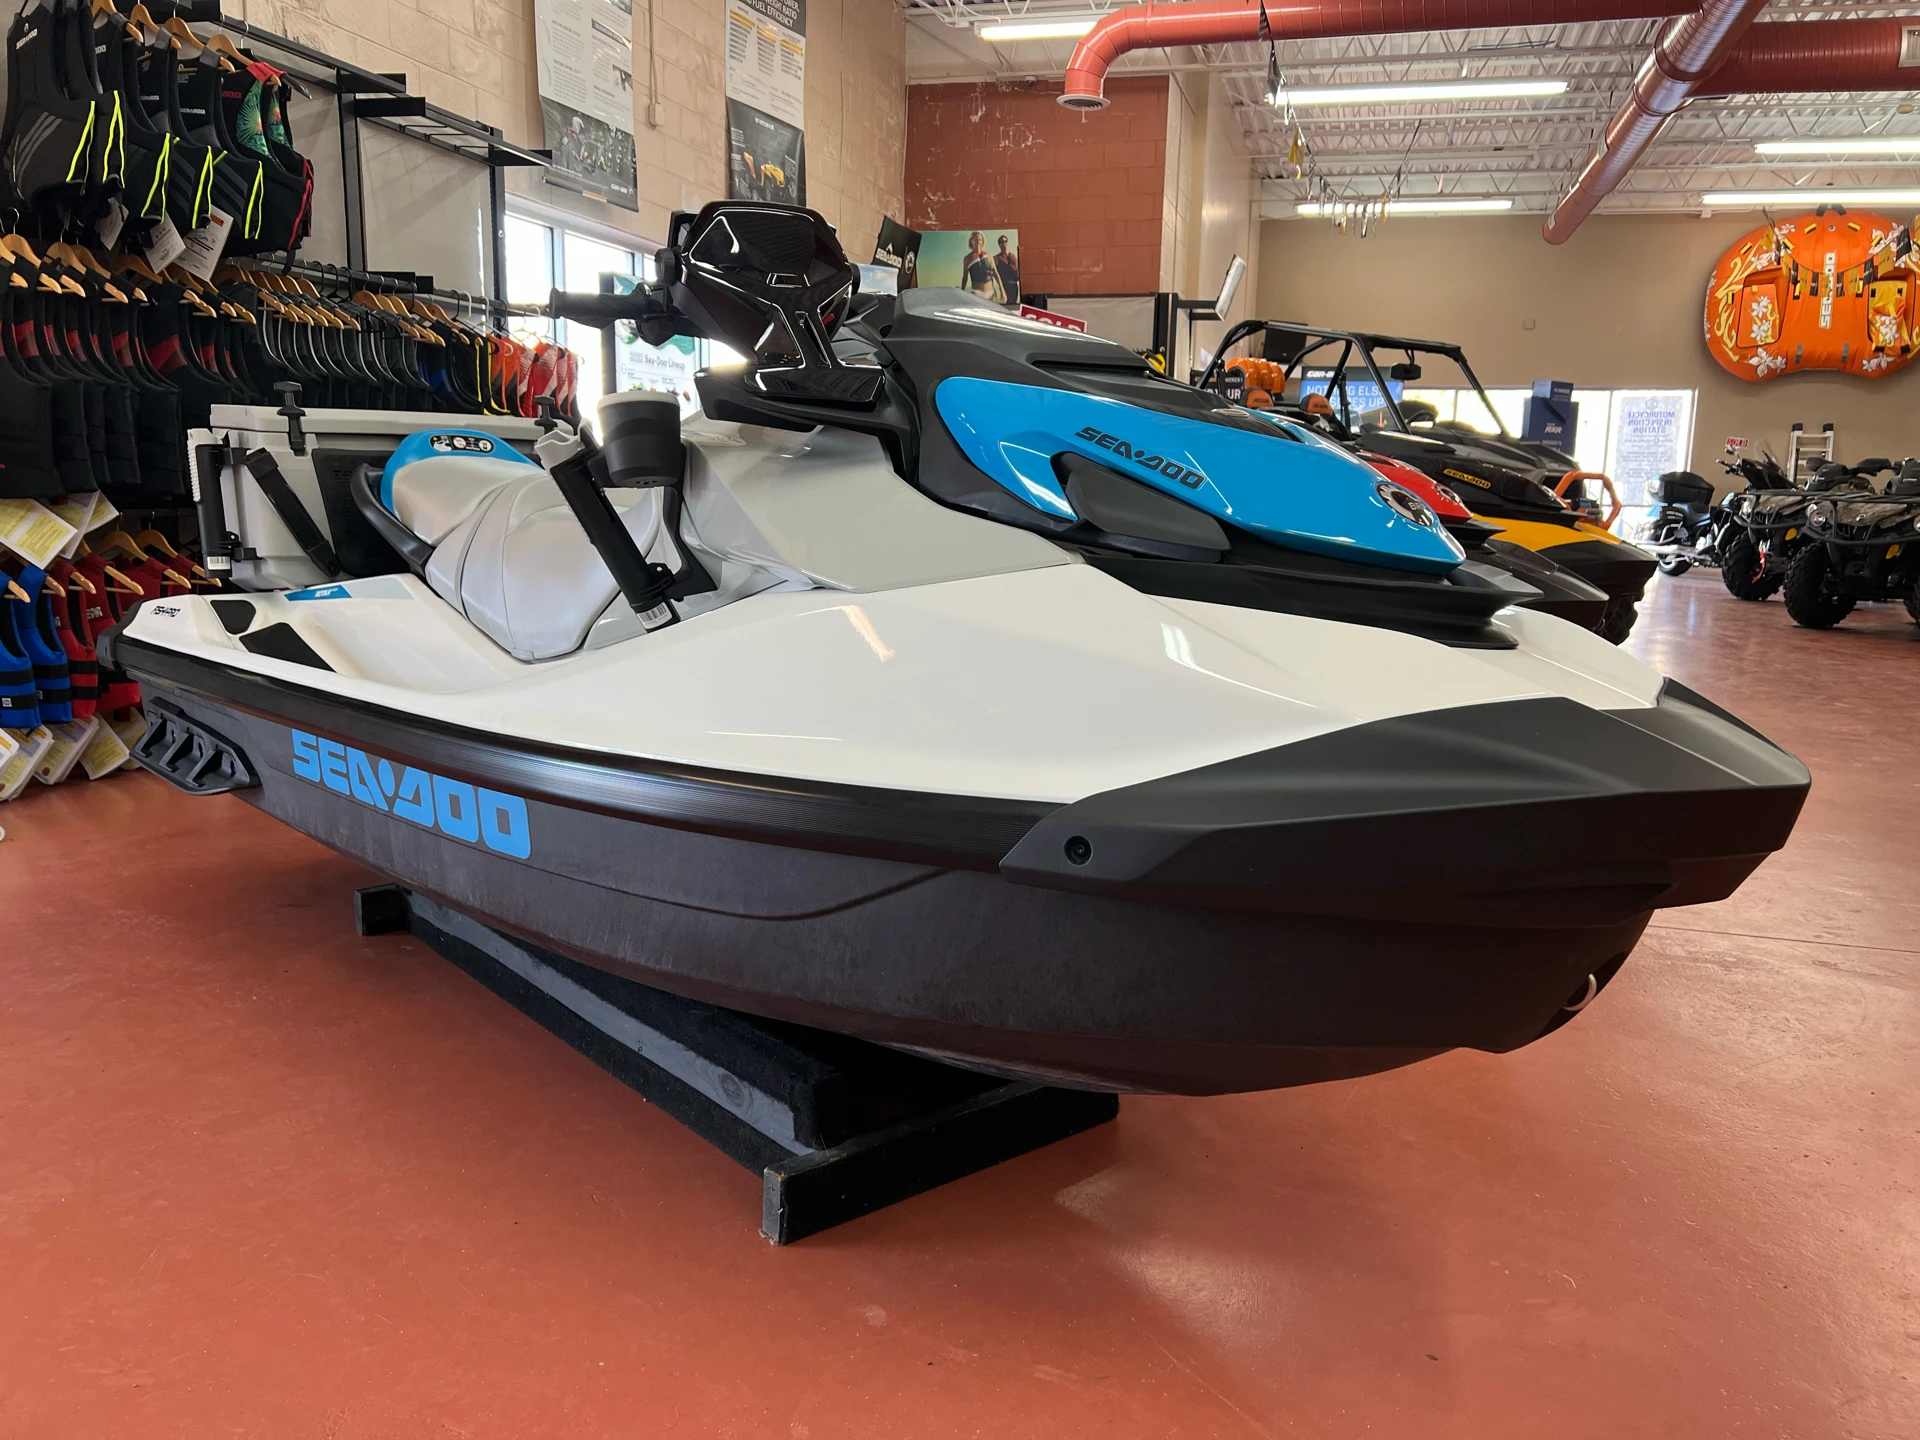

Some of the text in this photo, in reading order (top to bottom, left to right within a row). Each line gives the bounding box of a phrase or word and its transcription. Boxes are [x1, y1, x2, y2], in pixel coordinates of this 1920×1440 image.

[767, 5, 794, 27] EFFICIENCY
[782, 6, 798, 20] RATIO
[668, 359, 686, 373] Lineup
[1358, 385, 1381, 396] ELS
